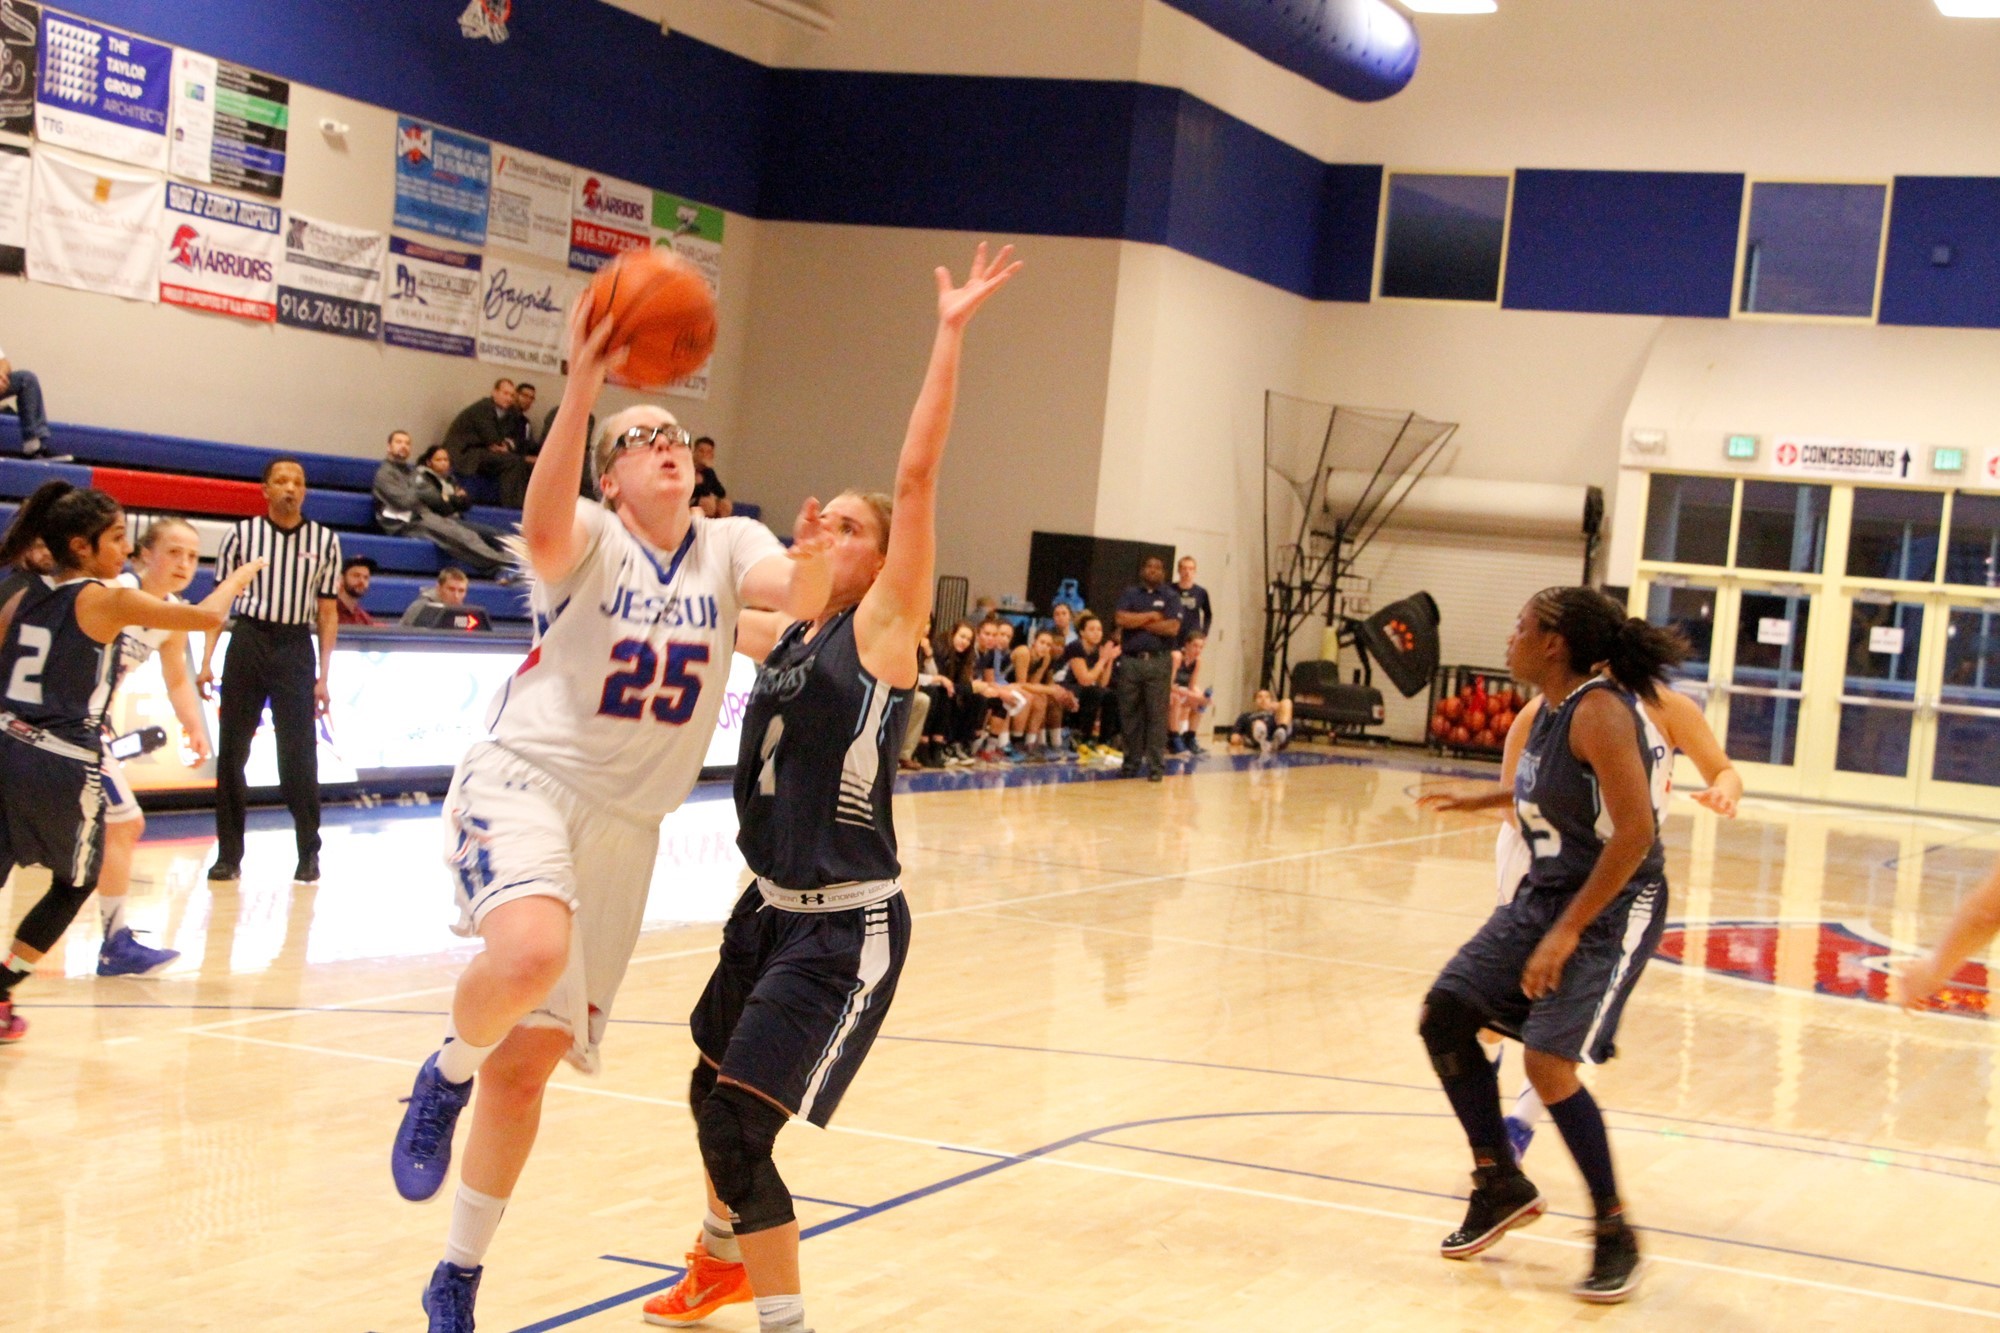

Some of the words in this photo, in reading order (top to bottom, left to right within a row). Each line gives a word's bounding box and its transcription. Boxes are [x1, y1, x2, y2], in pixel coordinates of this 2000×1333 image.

[108, 36, 130, 56] THE
[106, 56, 147, 82] TAYLOR
[103, 77, 144, 100] GROUP
[103, 98, 165, 127] ARCHITECTS
[596, 192, 644, 221] WARRIORS
[191, 244, 273, 283] WARRIORS
[1801, 444, 1896, 468] CONCESSIONS
[5, 623, 52, 705] 2
[597, 636, 710, 726] 25
